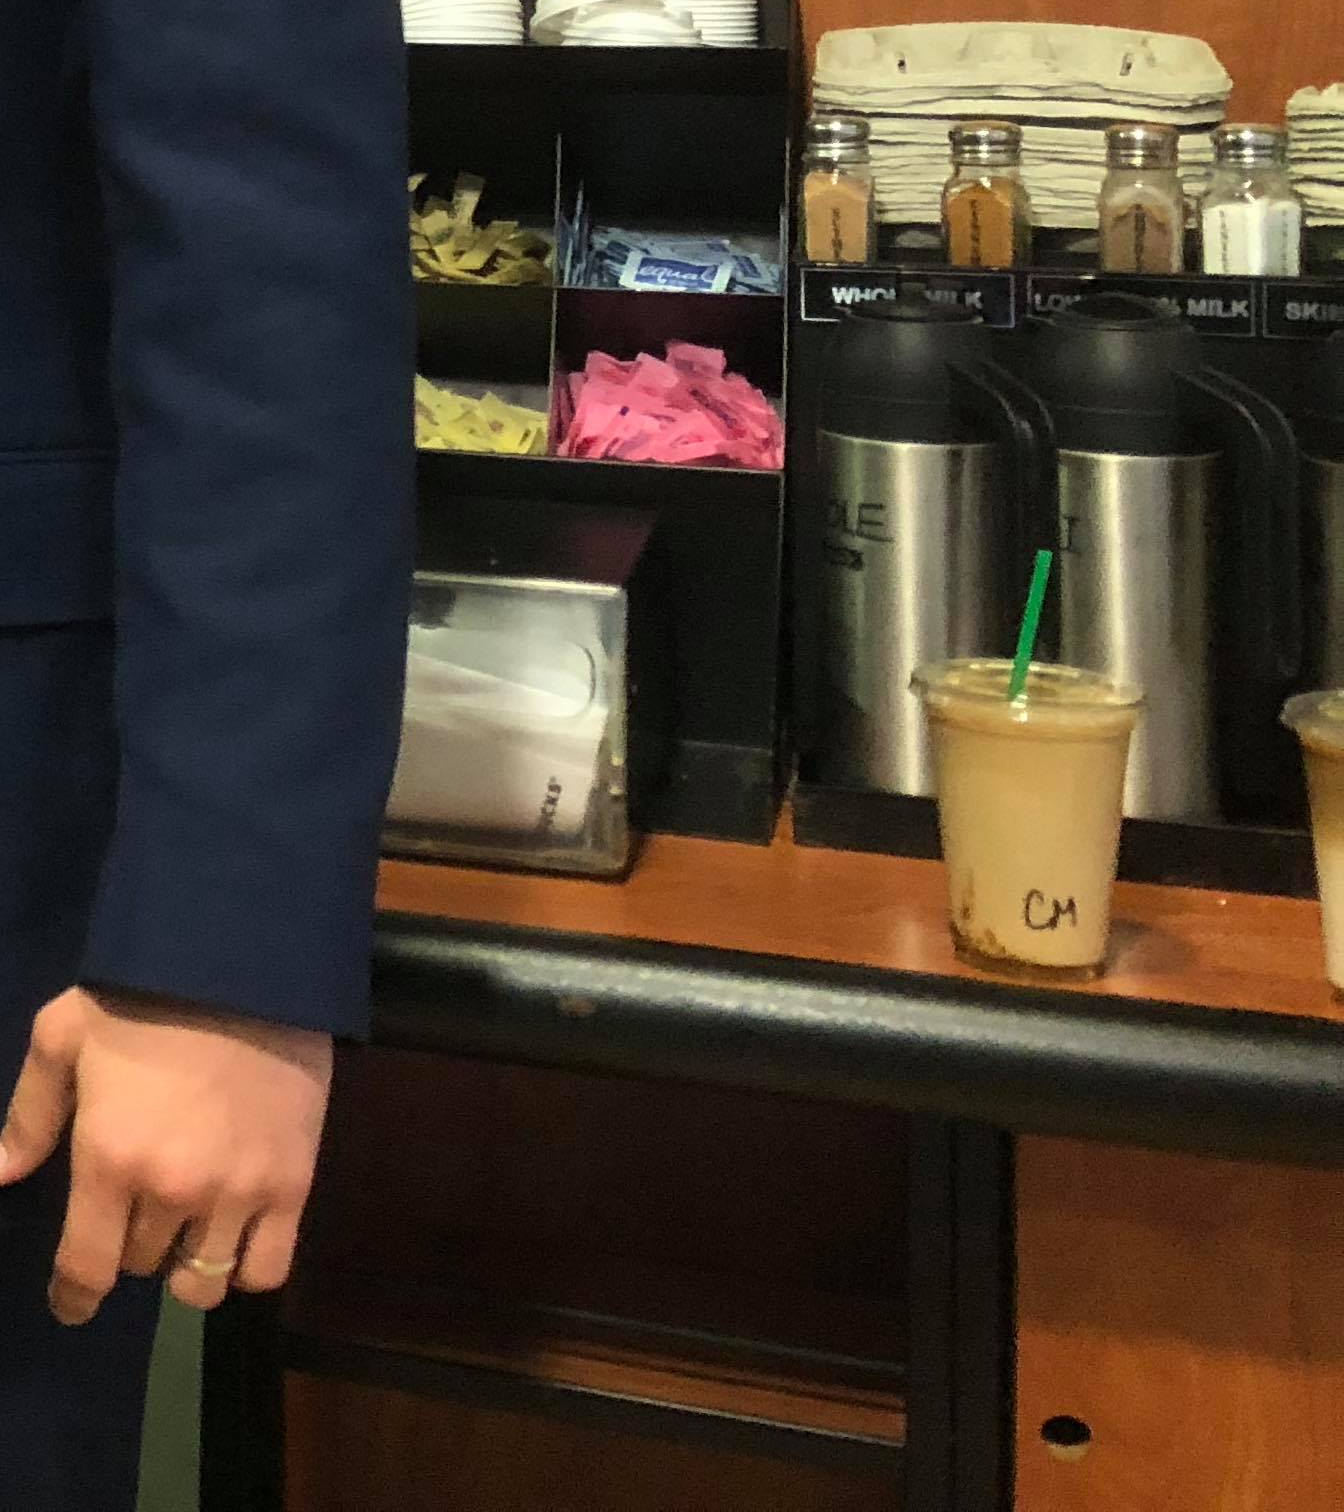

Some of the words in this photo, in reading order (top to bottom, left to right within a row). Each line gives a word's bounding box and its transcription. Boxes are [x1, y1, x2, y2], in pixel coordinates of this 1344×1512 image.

[639, 263, 717, 285] equal
[1187, 298, 1250, 318] MILK
[1024, 890, 1077, 930] CM
